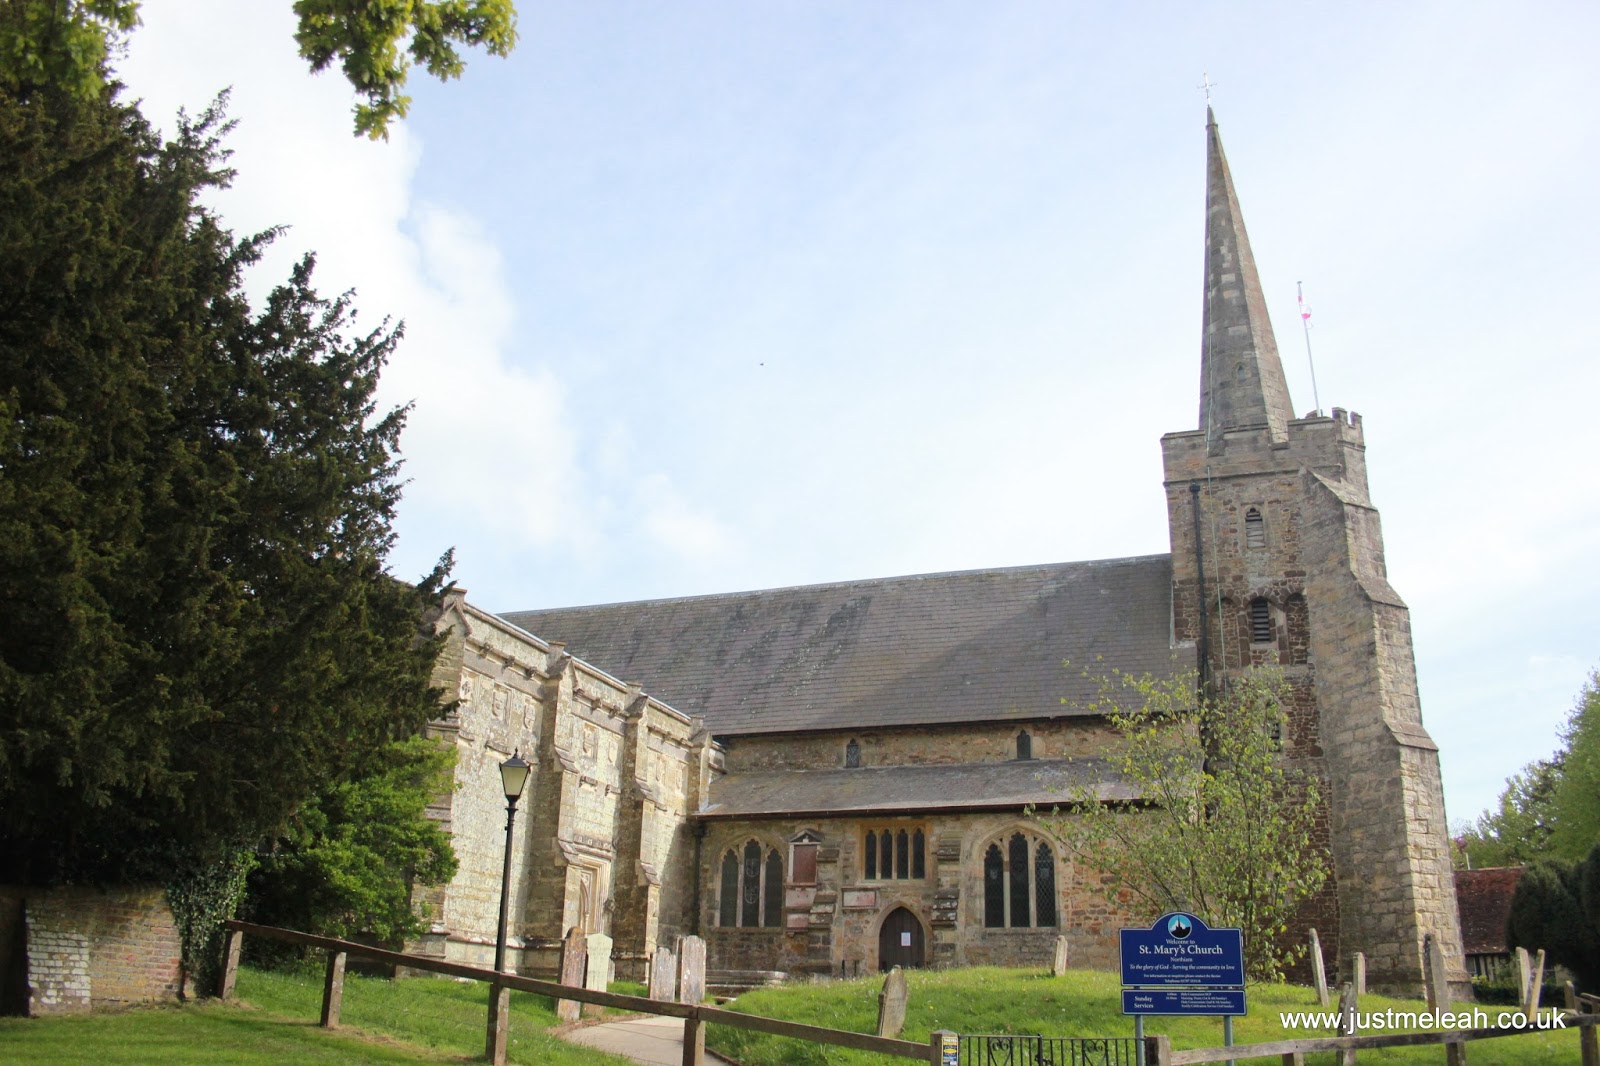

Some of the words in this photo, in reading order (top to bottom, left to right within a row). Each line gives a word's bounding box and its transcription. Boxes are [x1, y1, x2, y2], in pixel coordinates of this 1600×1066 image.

[1139, 945, 1151, 954] St.
[1154, 945, 1185, 957] Mary's
[1187, 945, 1223, 954] Church
